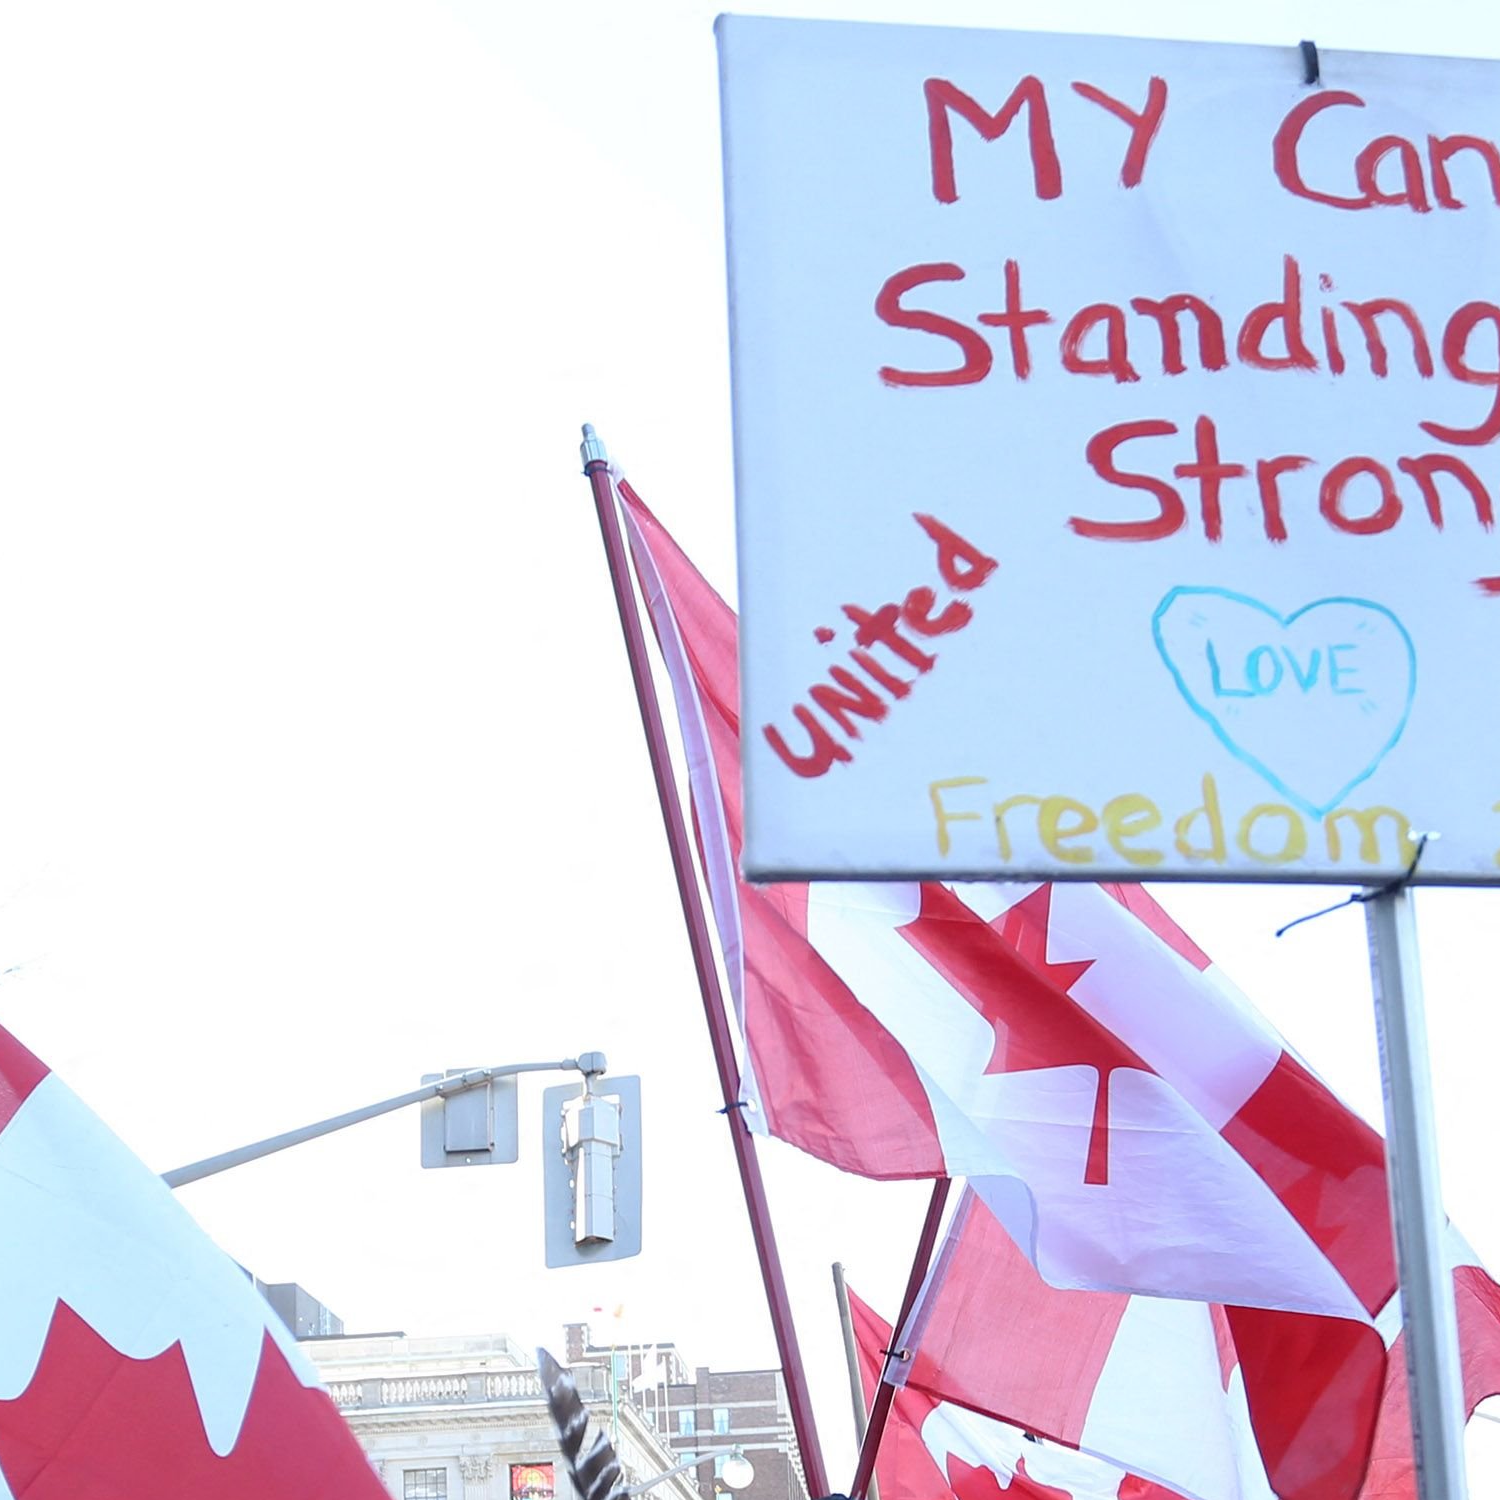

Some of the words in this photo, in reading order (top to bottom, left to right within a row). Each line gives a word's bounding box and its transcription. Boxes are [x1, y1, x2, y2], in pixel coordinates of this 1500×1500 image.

[923, 75, 1168, 204] MY
[1205, 638, 1366, 698] LOVE
[928, 771, 1420, 870] Freedom
